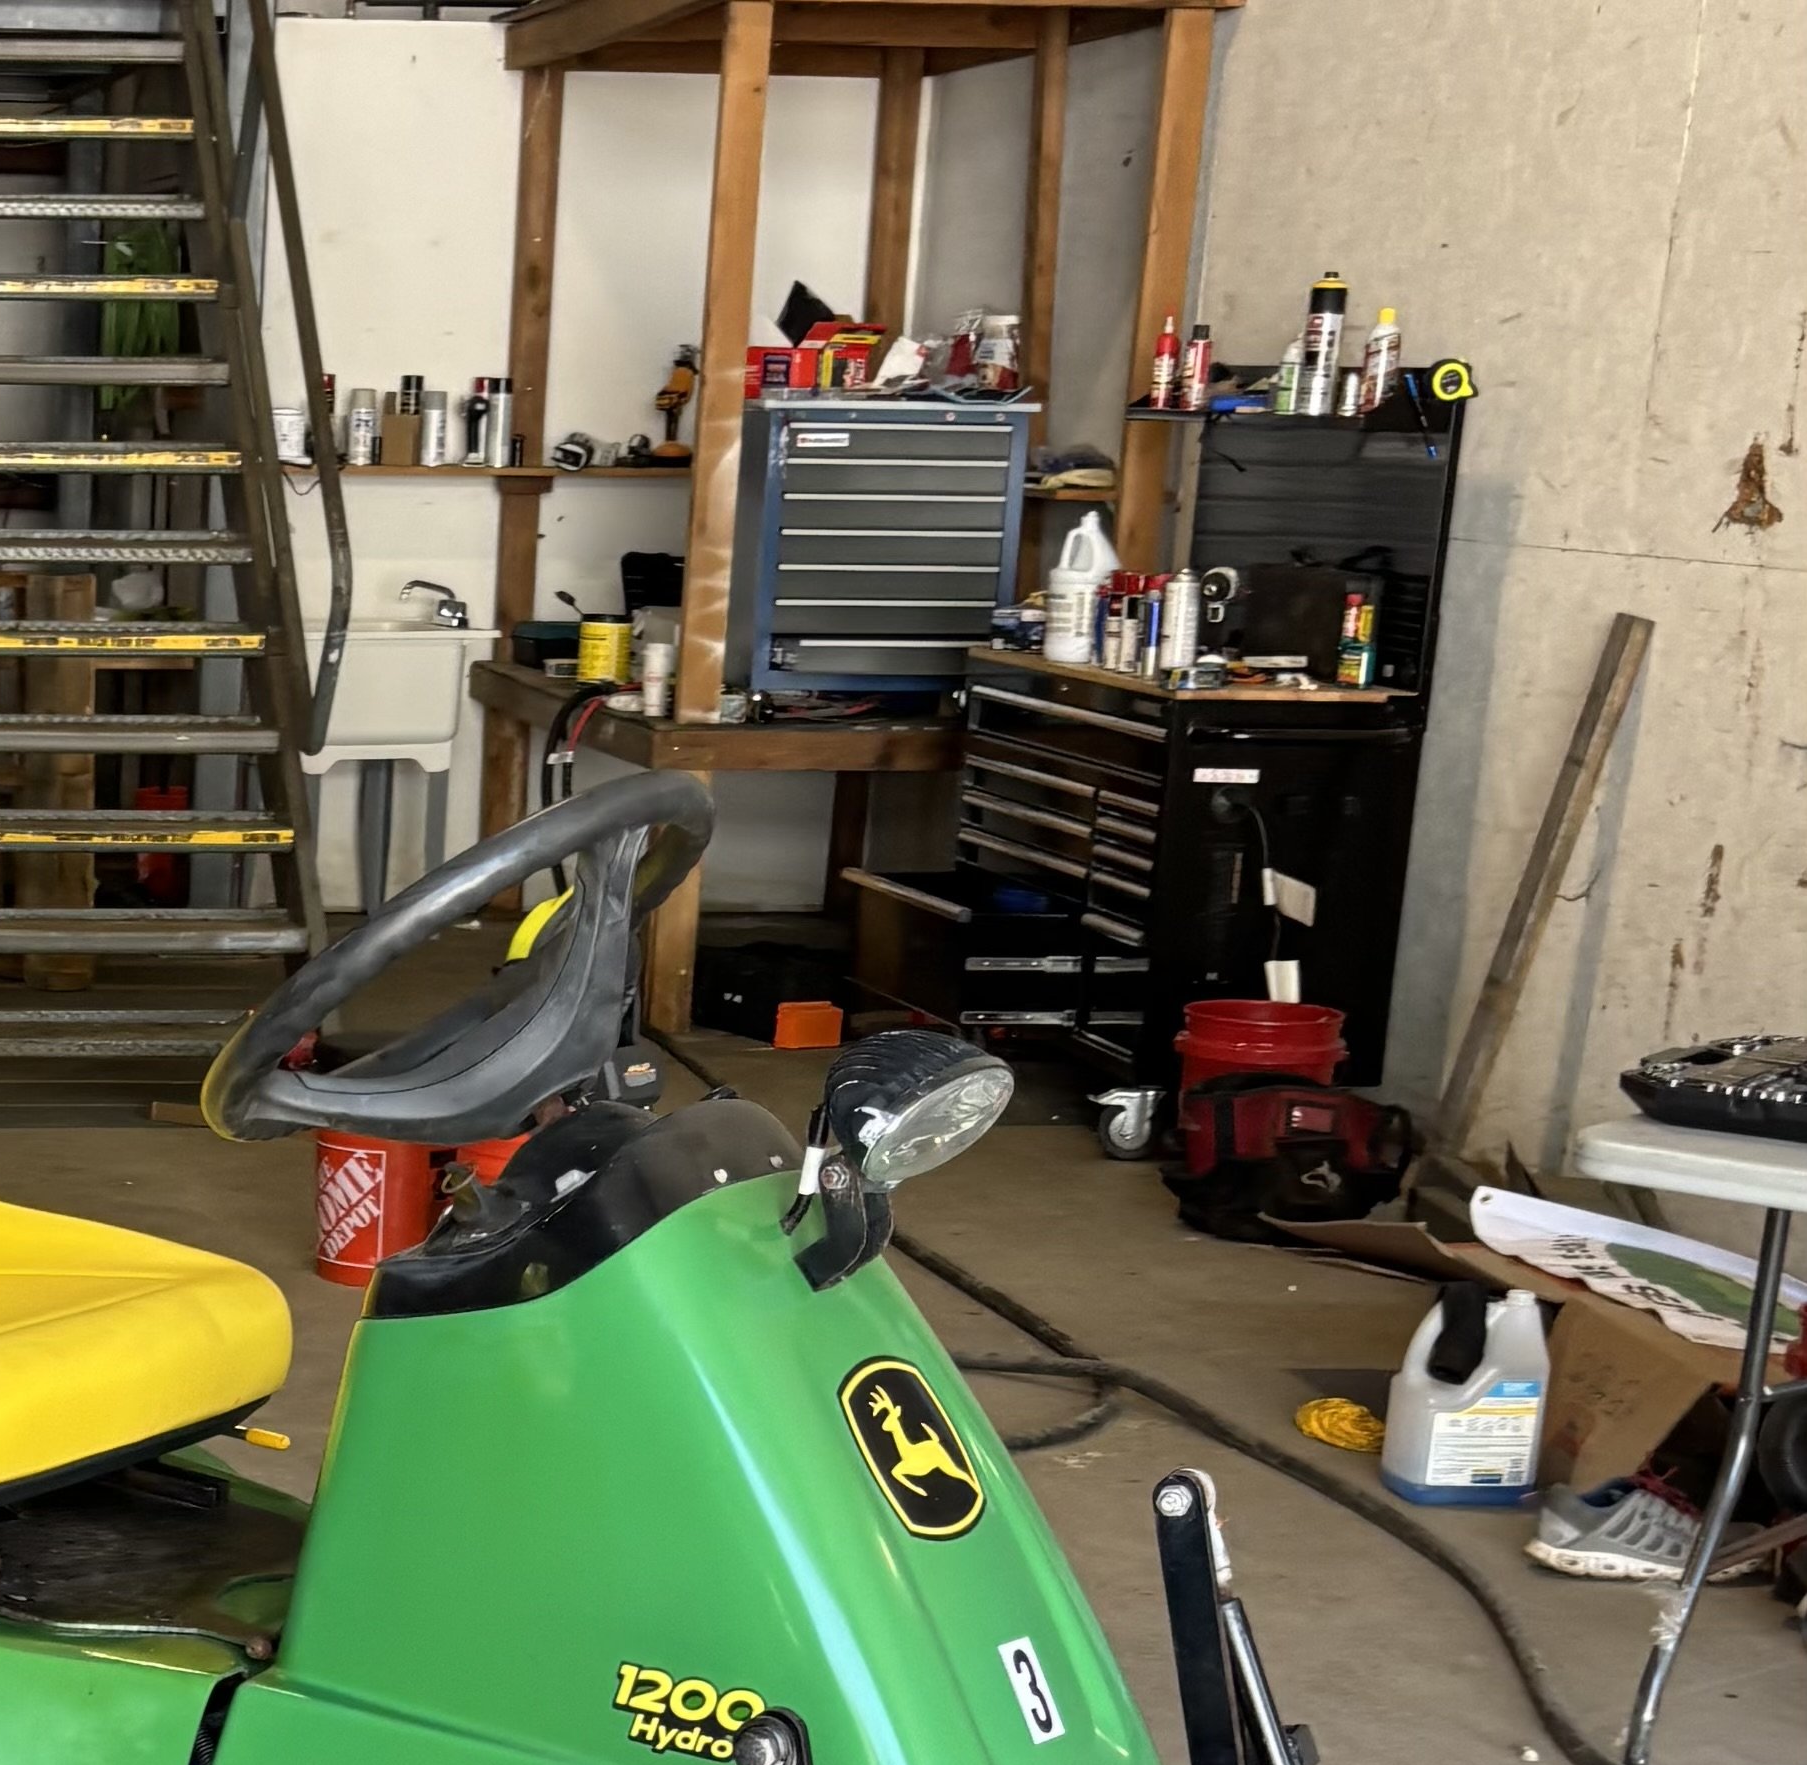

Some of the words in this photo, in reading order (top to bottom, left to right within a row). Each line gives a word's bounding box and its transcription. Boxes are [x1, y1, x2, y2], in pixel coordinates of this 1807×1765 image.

[318, 1152, 383, 1243] OME
[323, 1195, 381, 1259] DEPOT
[615, 1663, 766, 1732] 1200
[1012, 1648, 1053, 1734] 3
[630, 1713, 735, 1759] Hydro
